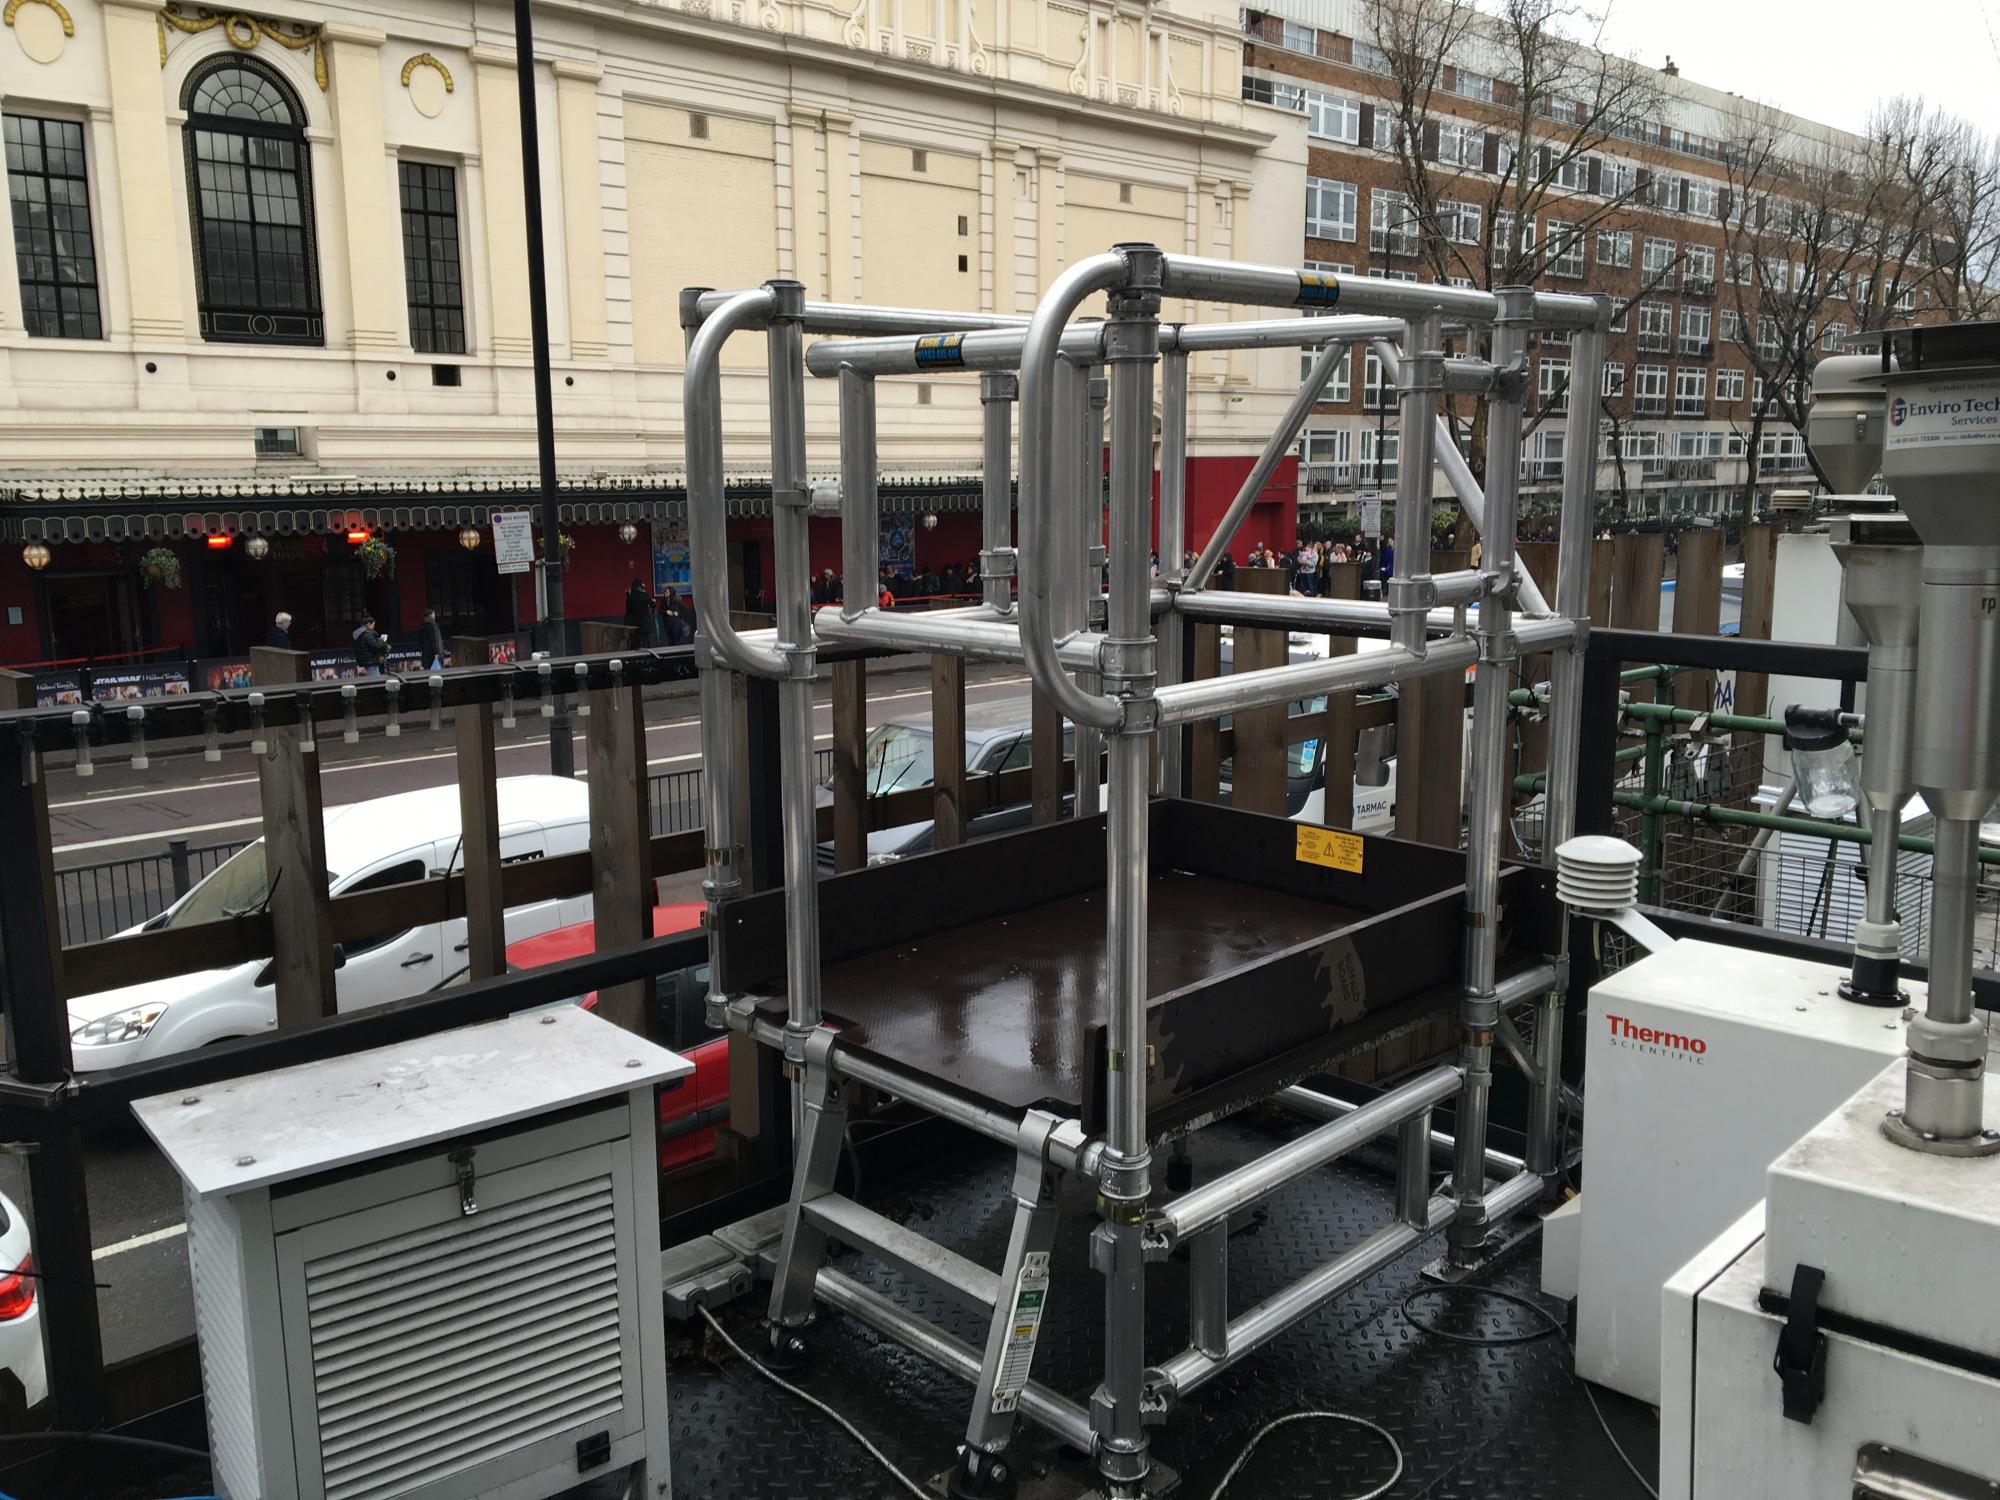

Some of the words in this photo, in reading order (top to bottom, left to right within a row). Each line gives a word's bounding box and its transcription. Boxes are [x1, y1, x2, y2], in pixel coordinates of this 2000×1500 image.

[1909, 401, 1961, 416] Enviro
[1951, 416, 1998, 426] Services
[1981, 597, 1997, 614] rp
[93, 676, 118, 685] STAR
[117, 675, 141, 683] WARS
[1357, 800, 1387, 815] TARMAC
[1606, 1014, 1707, 1055] Thermo
[1610, 1038, 1705, 1066] SCIENTIFIC
